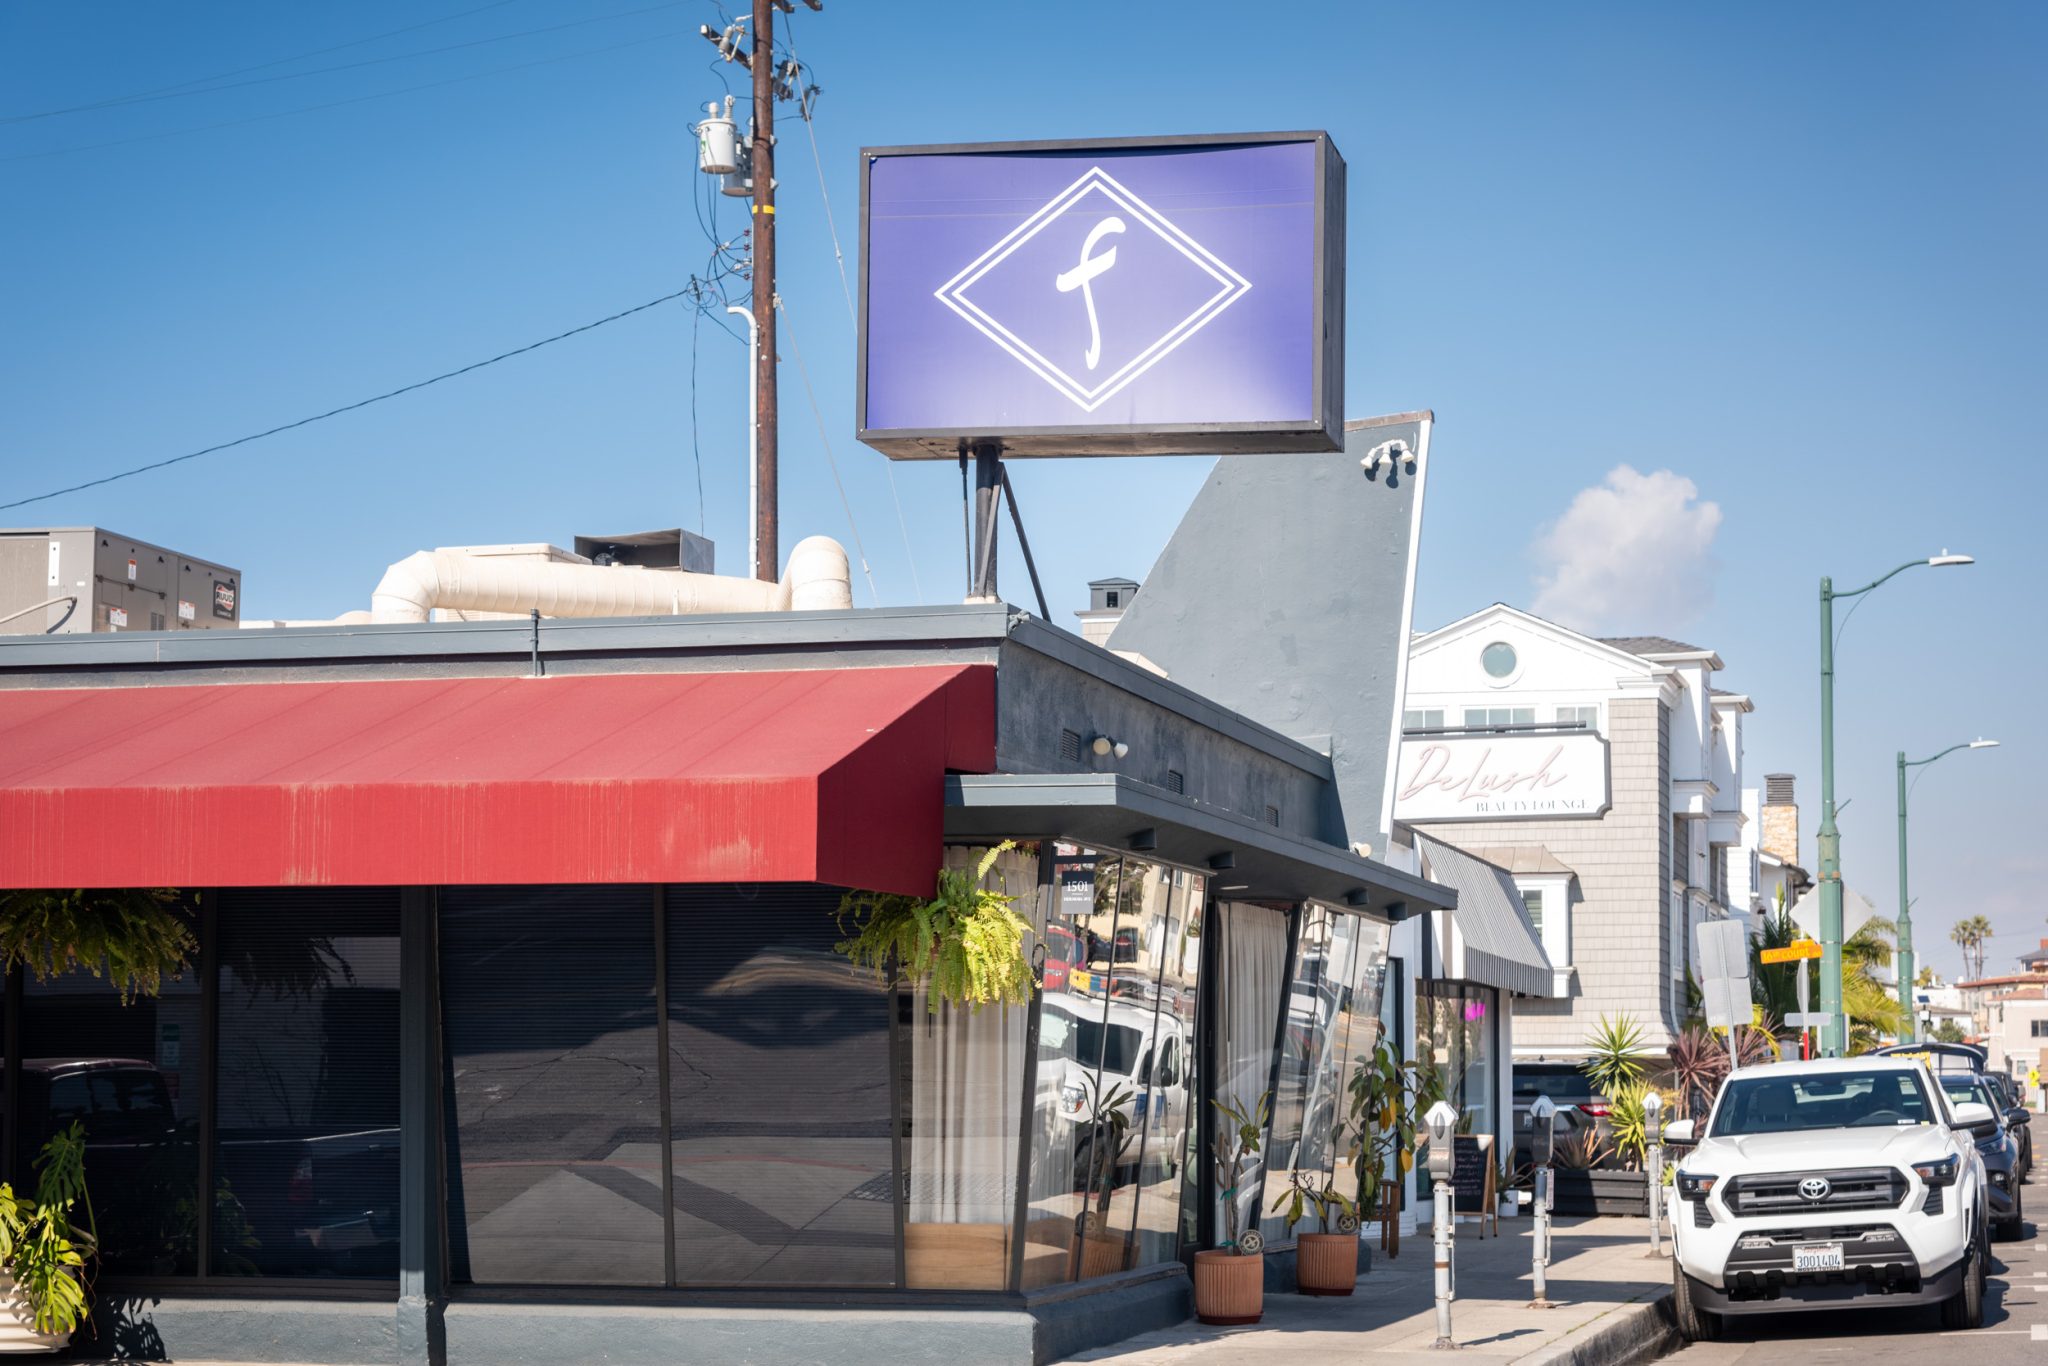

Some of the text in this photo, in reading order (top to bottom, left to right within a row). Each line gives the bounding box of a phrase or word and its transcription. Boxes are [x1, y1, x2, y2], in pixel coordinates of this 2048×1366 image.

[1056, 216, 1126, 370] f
[1400, 743, 1568, 802] DeLush
[1476, 799, 1590, 812] BEAUTY LOUNGE
[1067, 880, 1088, 892] 1501
